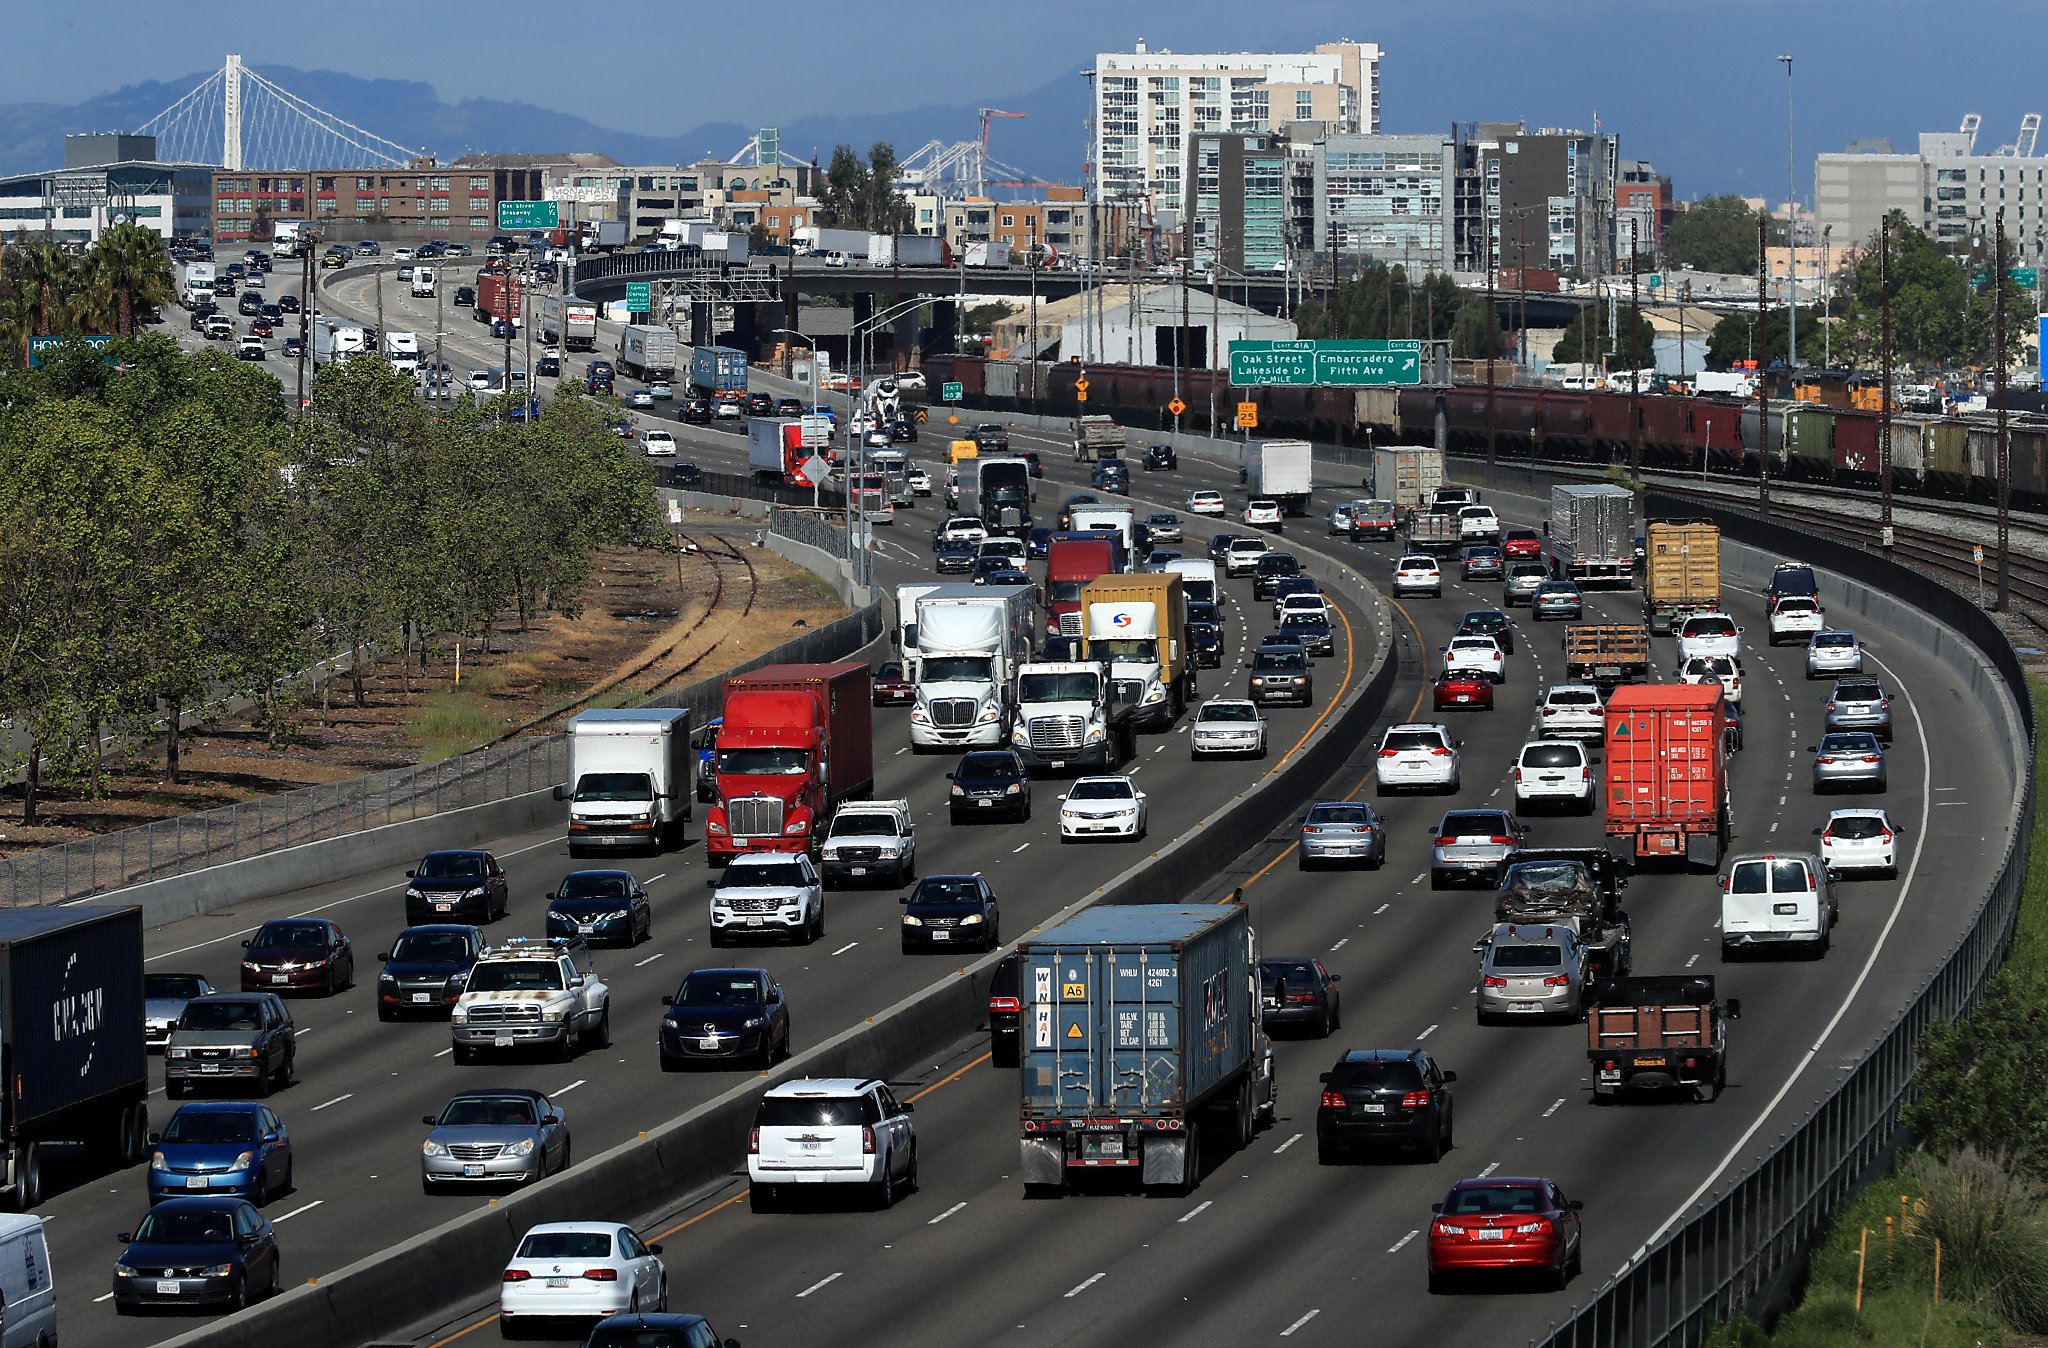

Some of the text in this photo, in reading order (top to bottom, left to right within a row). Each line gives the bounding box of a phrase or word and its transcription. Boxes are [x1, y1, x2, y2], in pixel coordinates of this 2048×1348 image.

[1242, 355, 1303, 363] Oak Street
[1320, 355, 1394, 363] Embarcadero
[1238, 367, 1306, 375] Lakeside Dr
[1330, 366, 1384, 375] Fifth Ave
[1254, 375, 1291, 384] 1/2 MILE
[1240, 413, 1254, 421] 25
[1120, 968, 1177, 977] WHLU 424082 3
[1037, 972, 1049, 1003] WAN
[1066, 986, 1082, 996] A6
[1039, 1012, 1048, 1042] HAI
